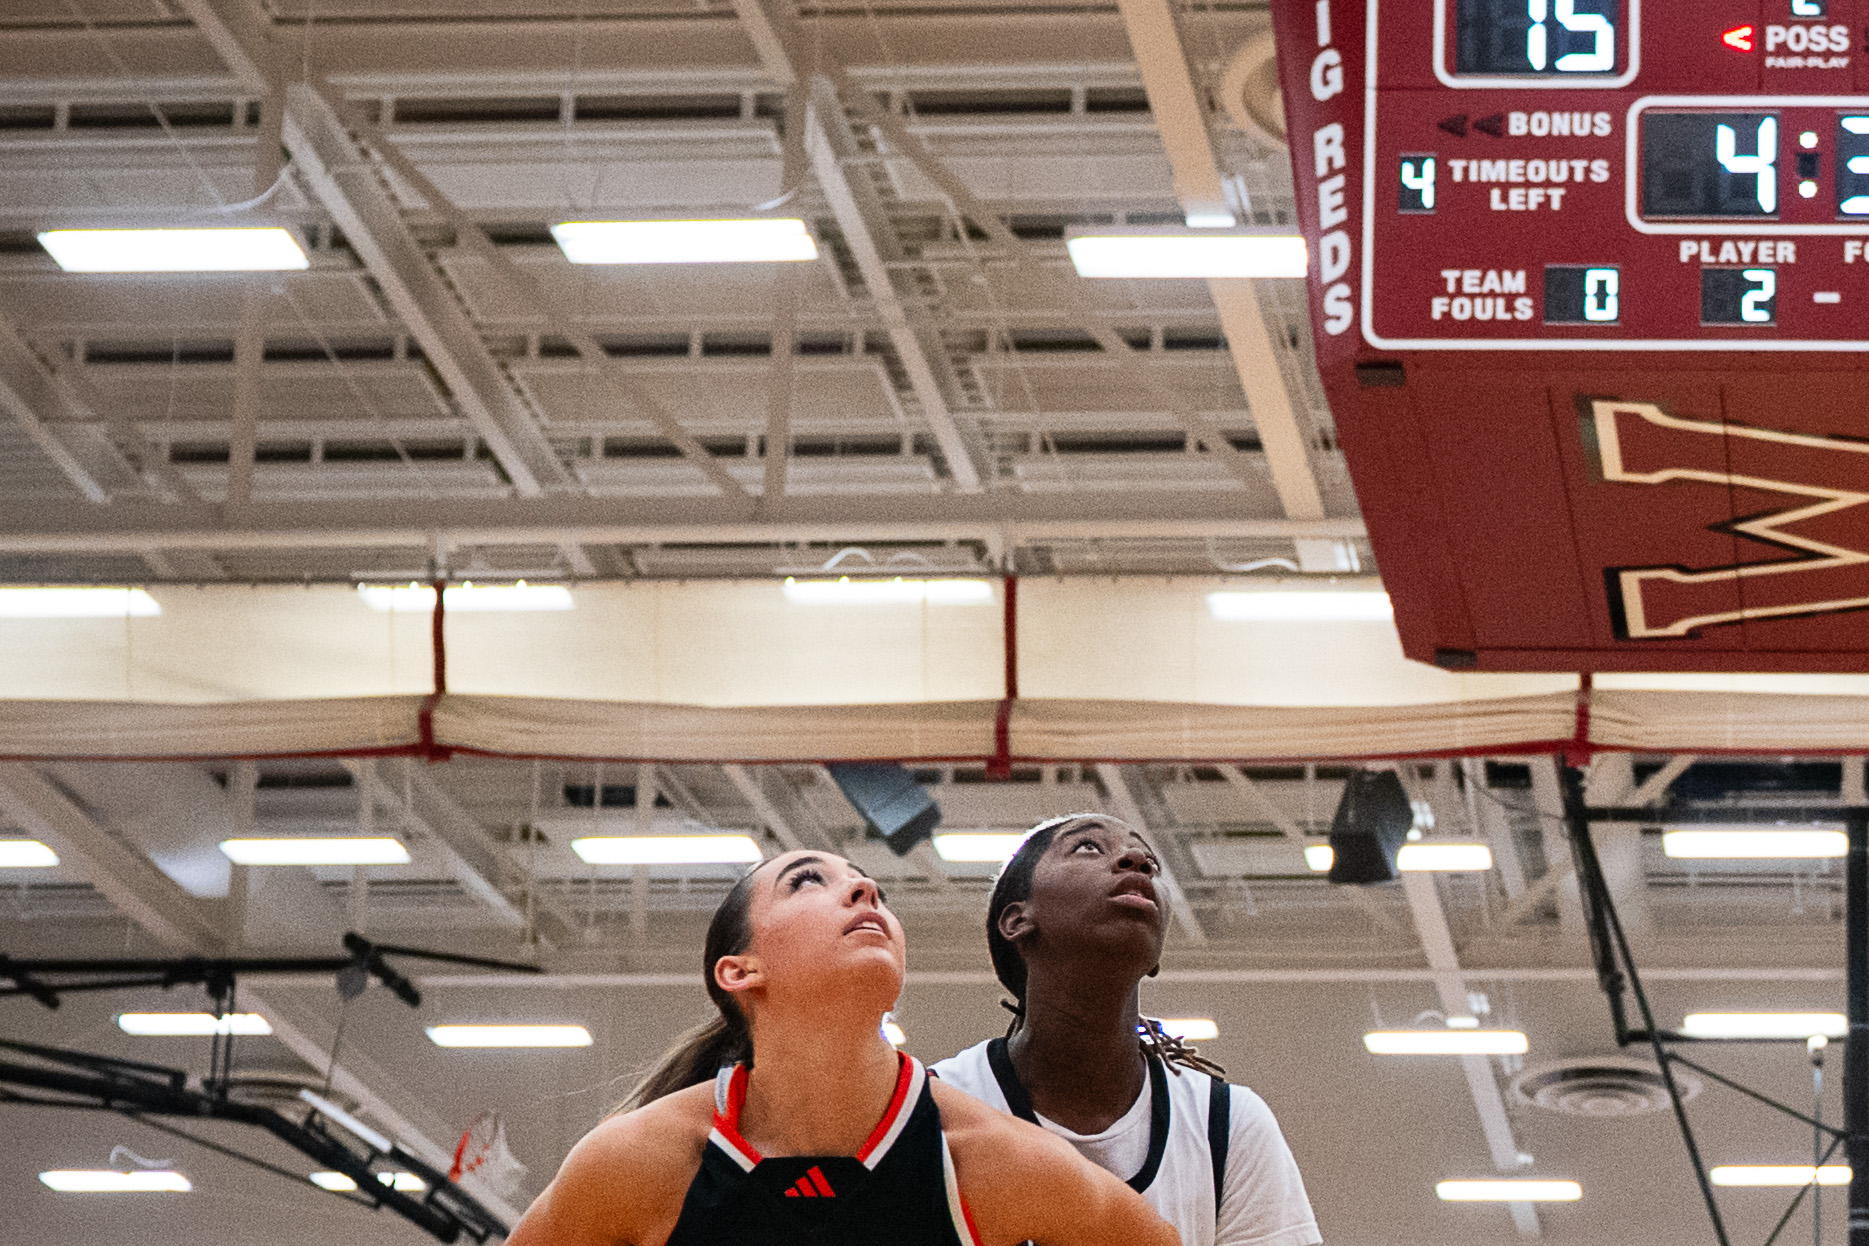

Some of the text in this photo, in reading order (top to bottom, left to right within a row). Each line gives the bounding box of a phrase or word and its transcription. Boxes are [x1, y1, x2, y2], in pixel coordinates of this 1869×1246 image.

[1528, 0, 1614, 71] 15
[1765, 25, 1850, 52] POSS
[1508, 112, 1612, 136] BONUS
[1401, 158, 1436, 209] 4
[1448, 160, 1610, 183] TIMEOUTS
[1490, 188, 1566, 210] LEFT
[1313, 122, 1353, 336] REDS
[1679, 241, 1796, 264] PLAYER
[1441, 270, 1526, 293] TEAM
[1584, 268, 1619, 321] 0
[1741, 269, 1776, 321] 2
[1431, 297, 1534, 321] FOULS
